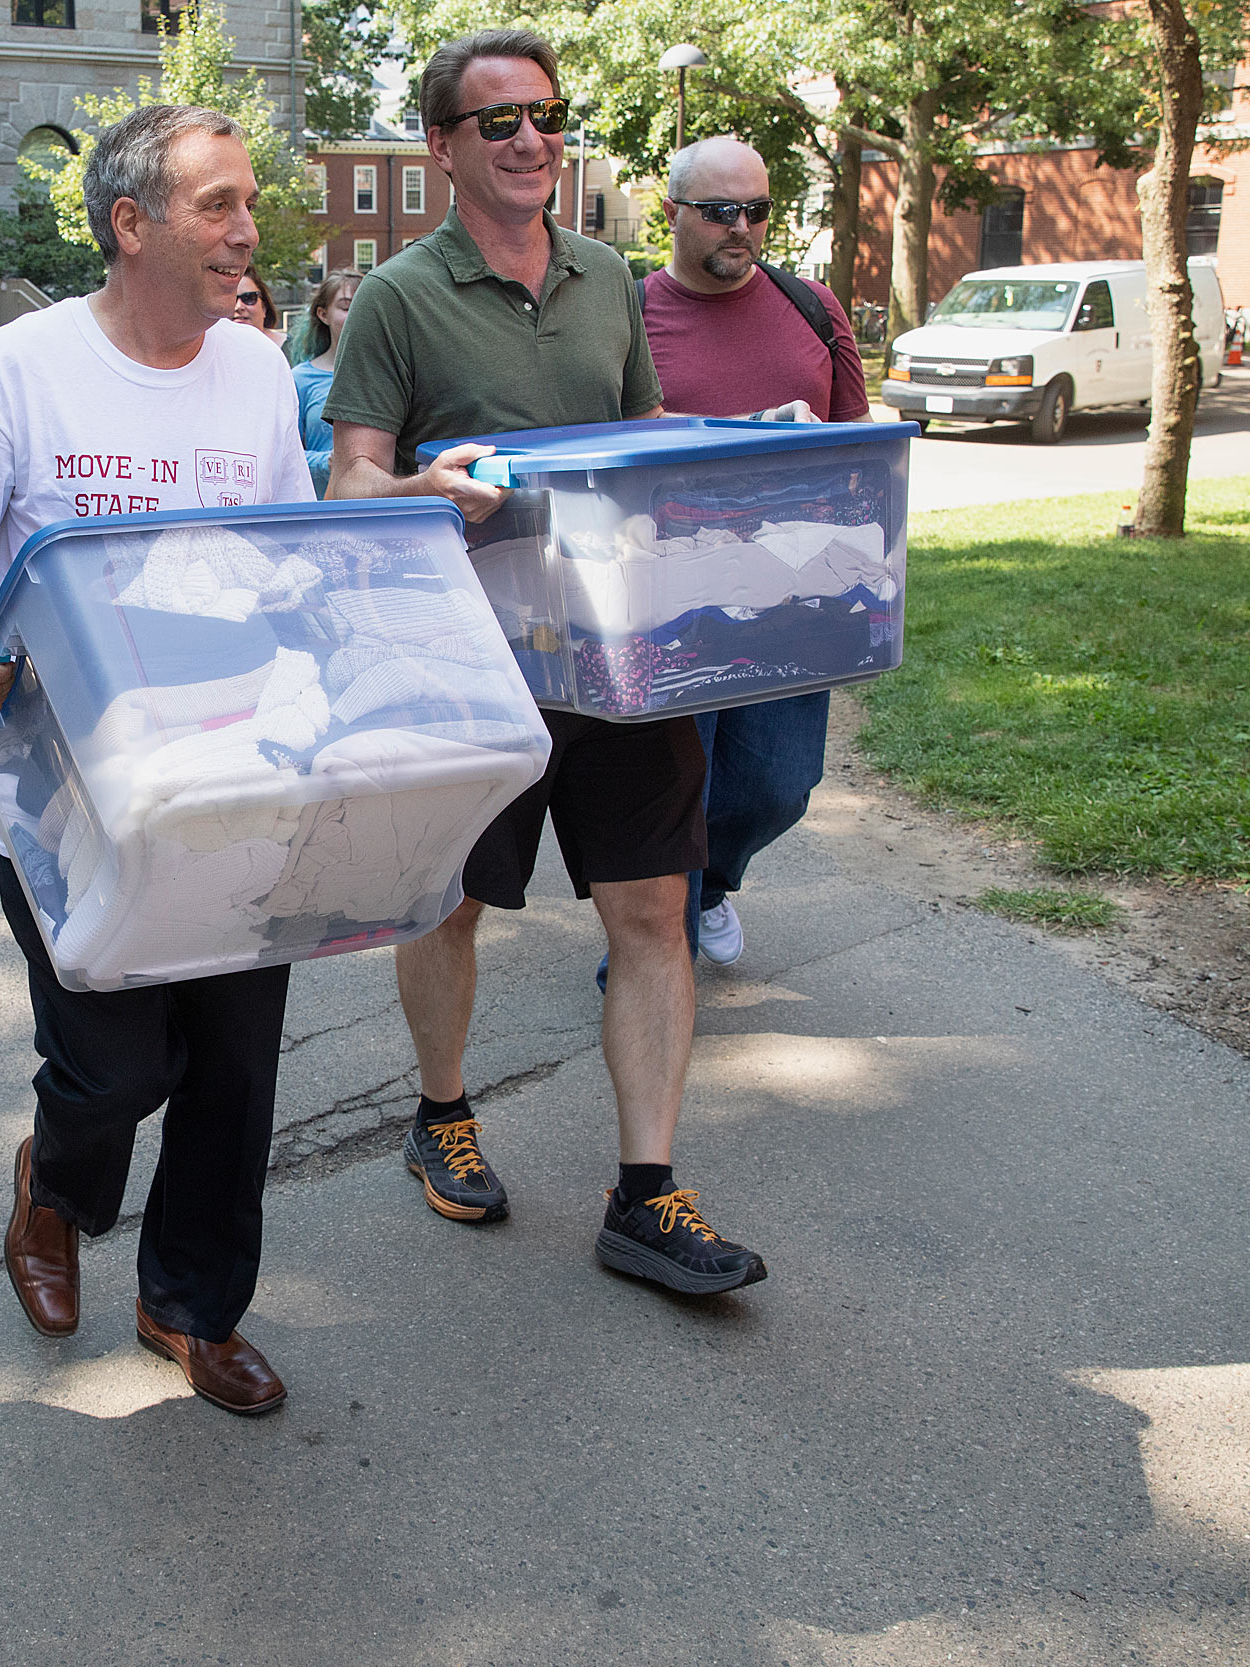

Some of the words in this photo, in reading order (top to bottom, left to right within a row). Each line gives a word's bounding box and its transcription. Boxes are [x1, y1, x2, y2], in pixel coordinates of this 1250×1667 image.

[55, 455, 179, 484] MOVE-IN
[206, 461, 222, 474] VE
[237, 463, 250, 477] RI
[75, 493, 159, 517] STAFF
